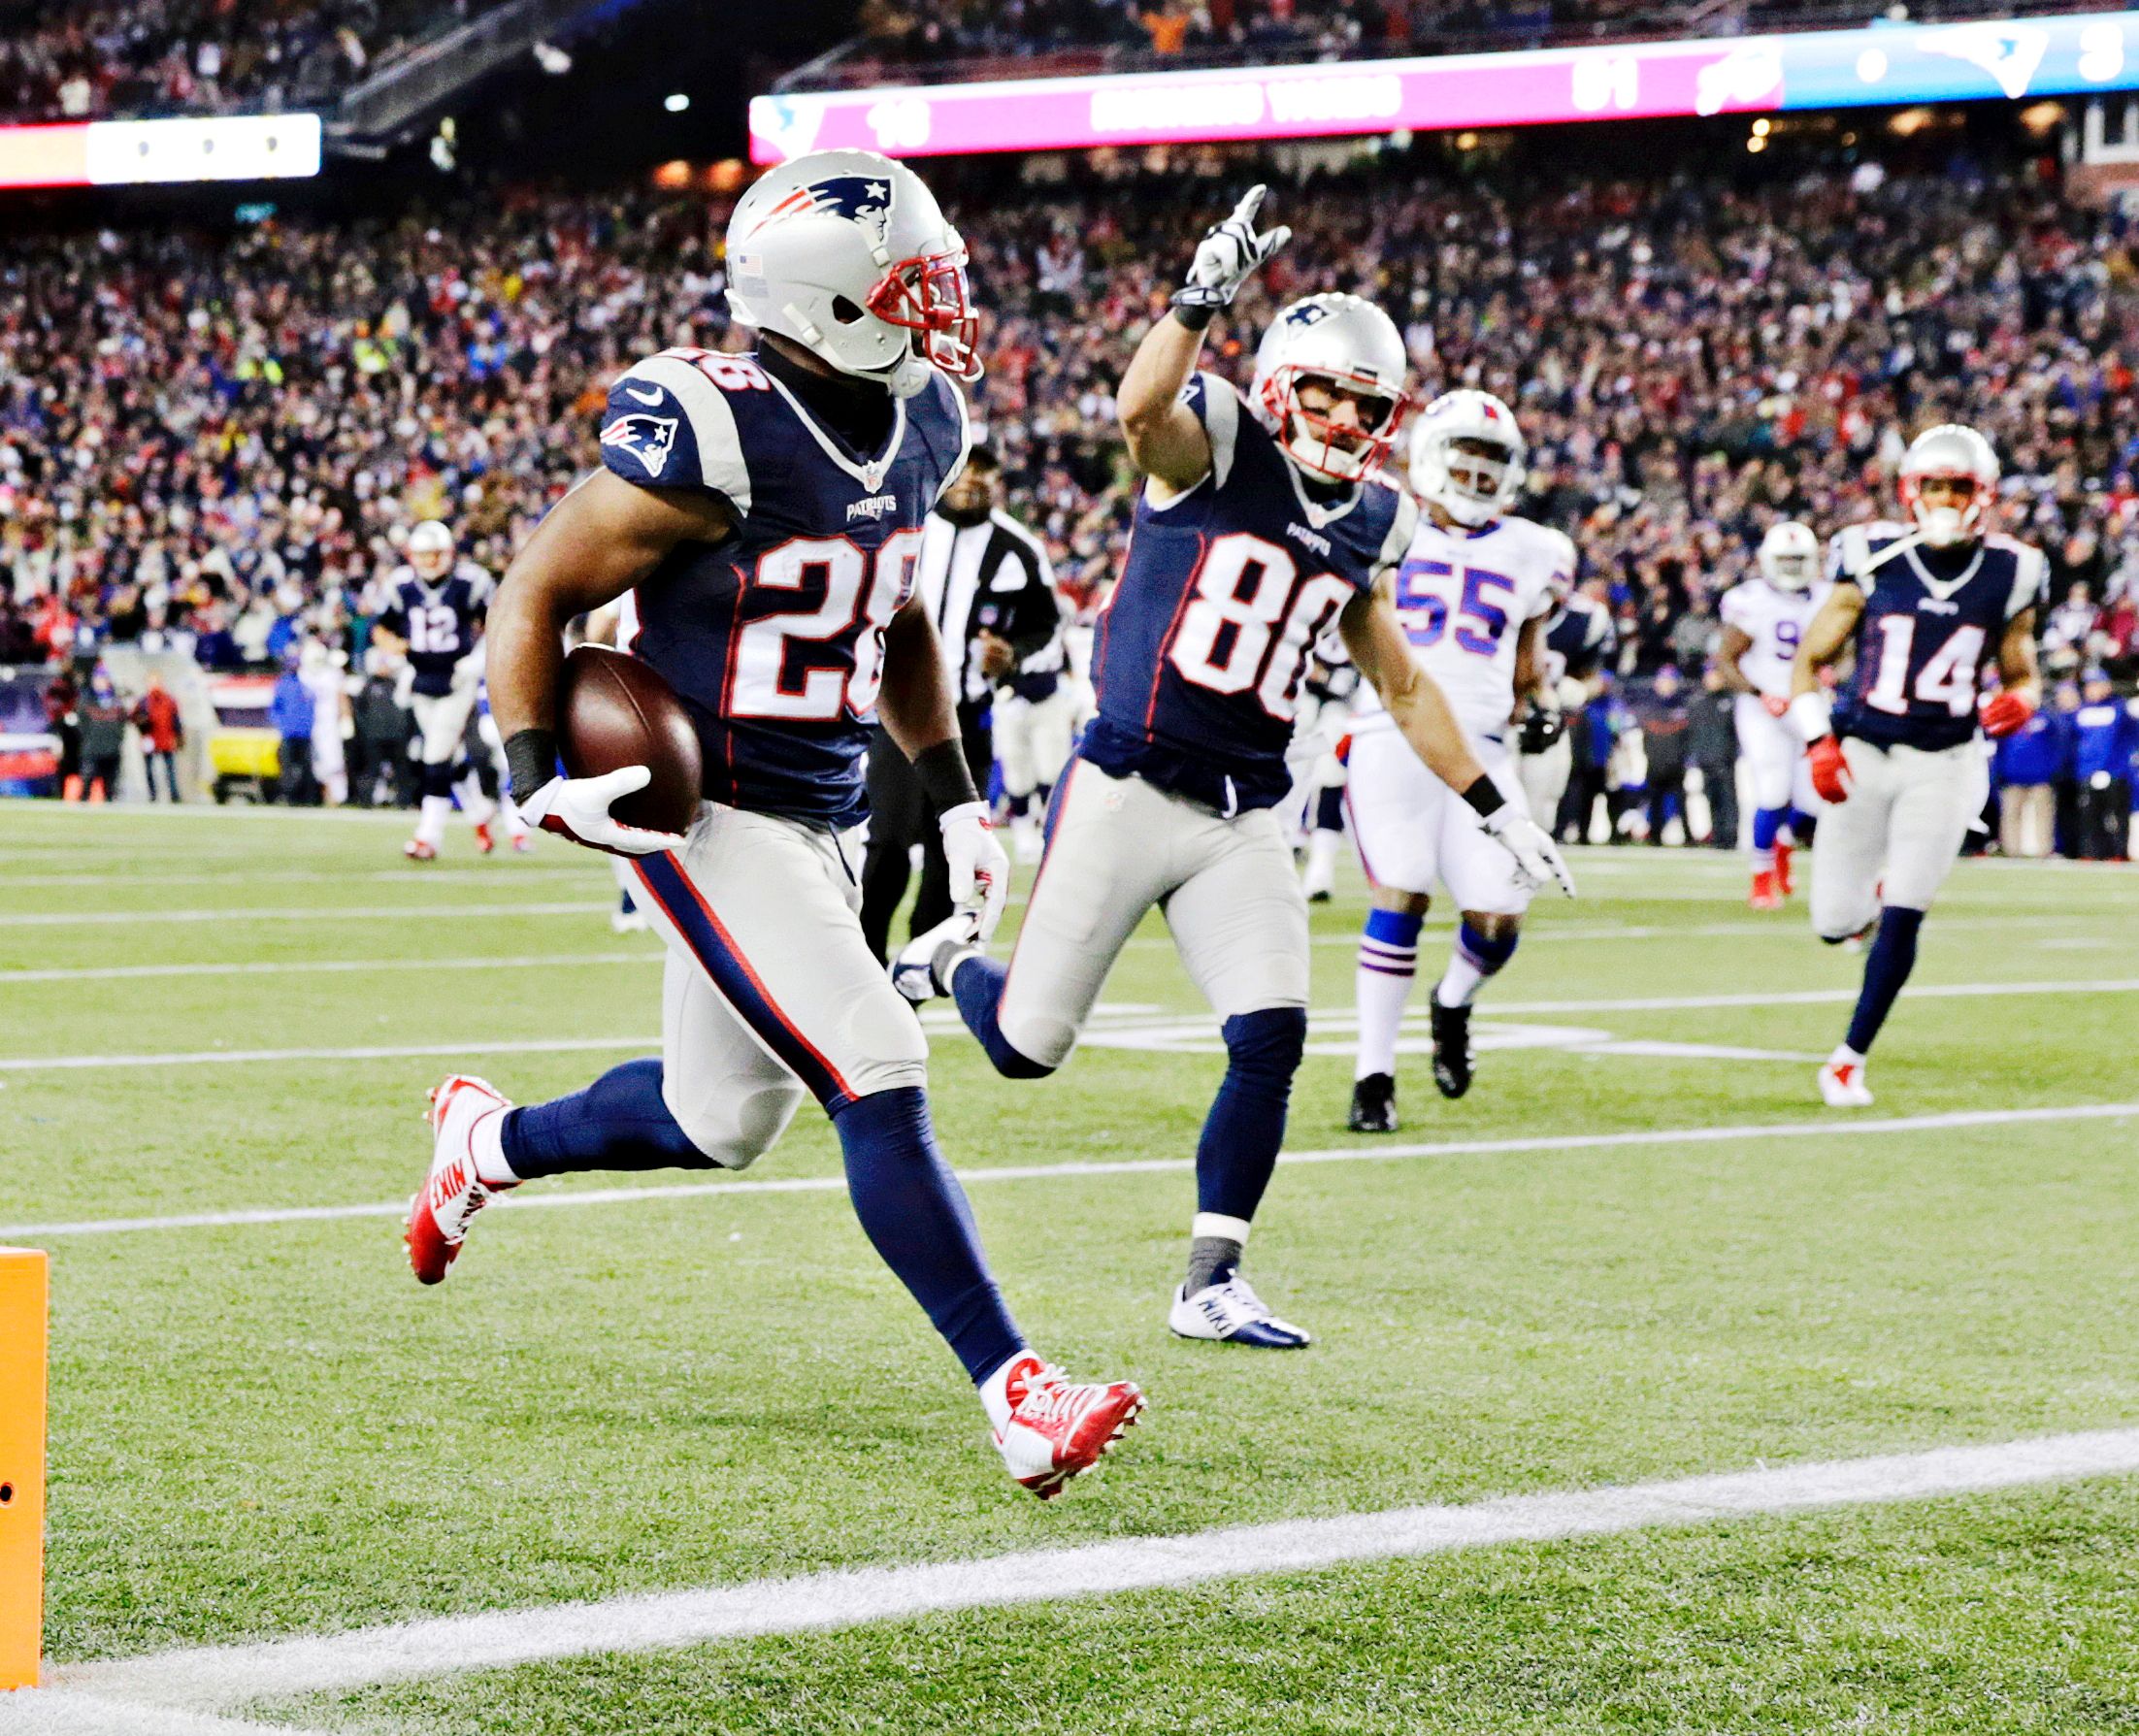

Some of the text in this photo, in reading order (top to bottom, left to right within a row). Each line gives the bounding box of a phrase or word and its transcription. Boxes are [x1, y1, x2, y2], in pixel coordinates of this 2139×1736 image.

[408, 604, 460, 654] 12
[730, 527, 926, 722] 28
[1168, 531, 1358, 723] 80
[1396, 557, 1518, 658] 55
[1865, 612, 1987, 718] 14
